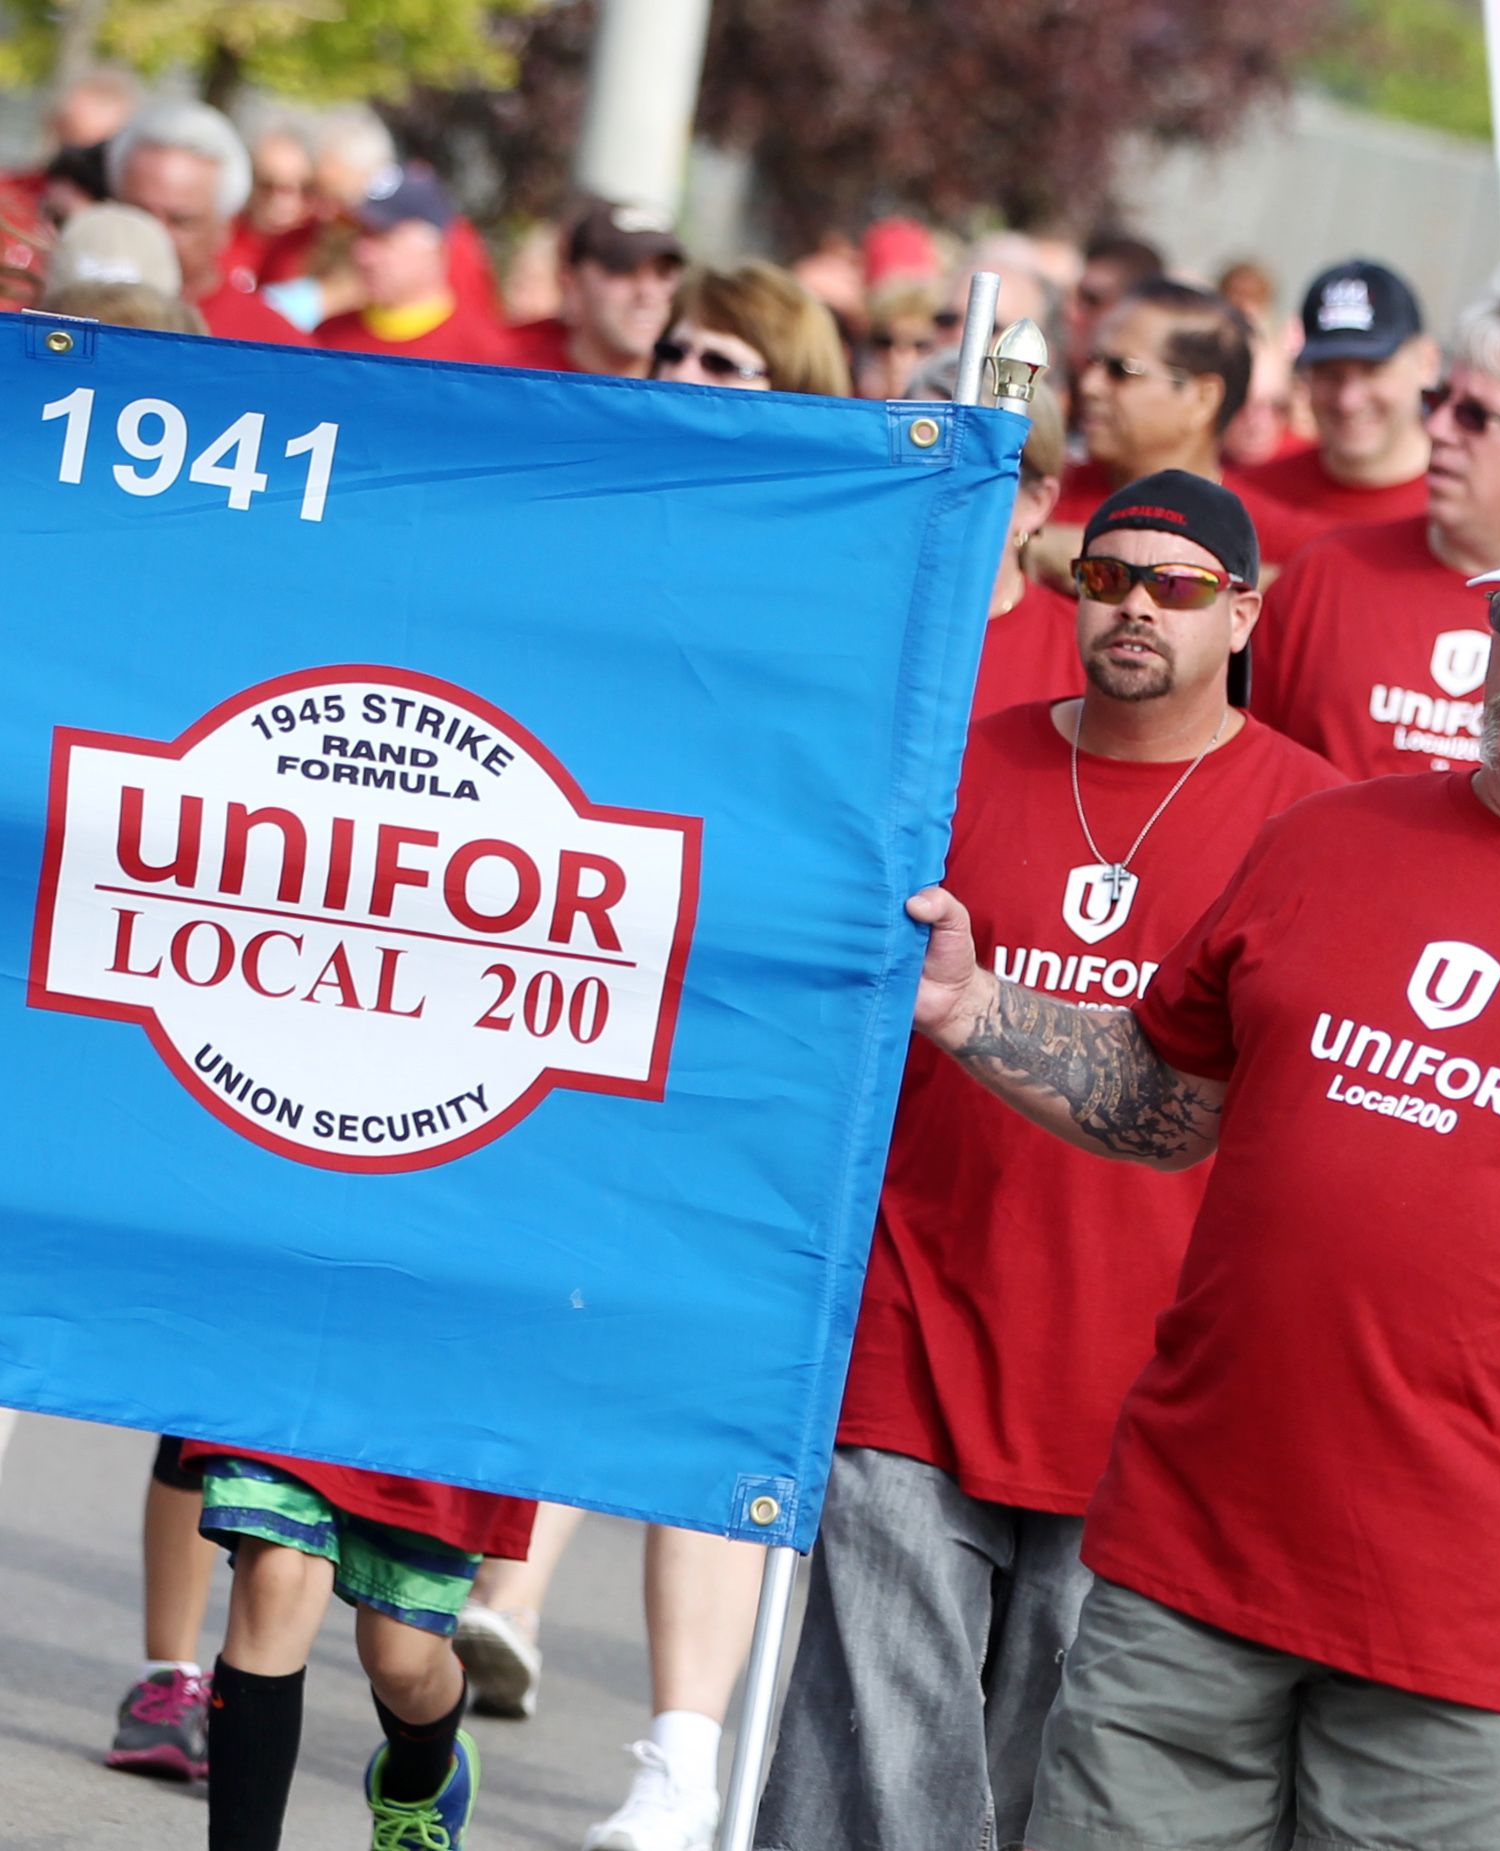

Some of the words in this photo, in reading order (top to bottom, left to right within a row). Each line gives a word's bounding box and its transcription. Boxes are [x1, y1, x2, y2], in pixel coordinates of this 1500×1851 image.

[42, 387, 339, 522] 1941
[251, 694, 345, 740] 1945
[361, 692, 515, 777] STRIKE
[321, 734, 439, 769] RAND
[277, 754, 480, 802] FORMULA
[106, 907, 425, 1019] LOCAL
[473, 962, 611, 1046] 200
[194, 1043, 304, 1130] UNION
[313, 1084, 489, 1145] SECURITY
[1325, 1073, 1459, 1135] Local200
